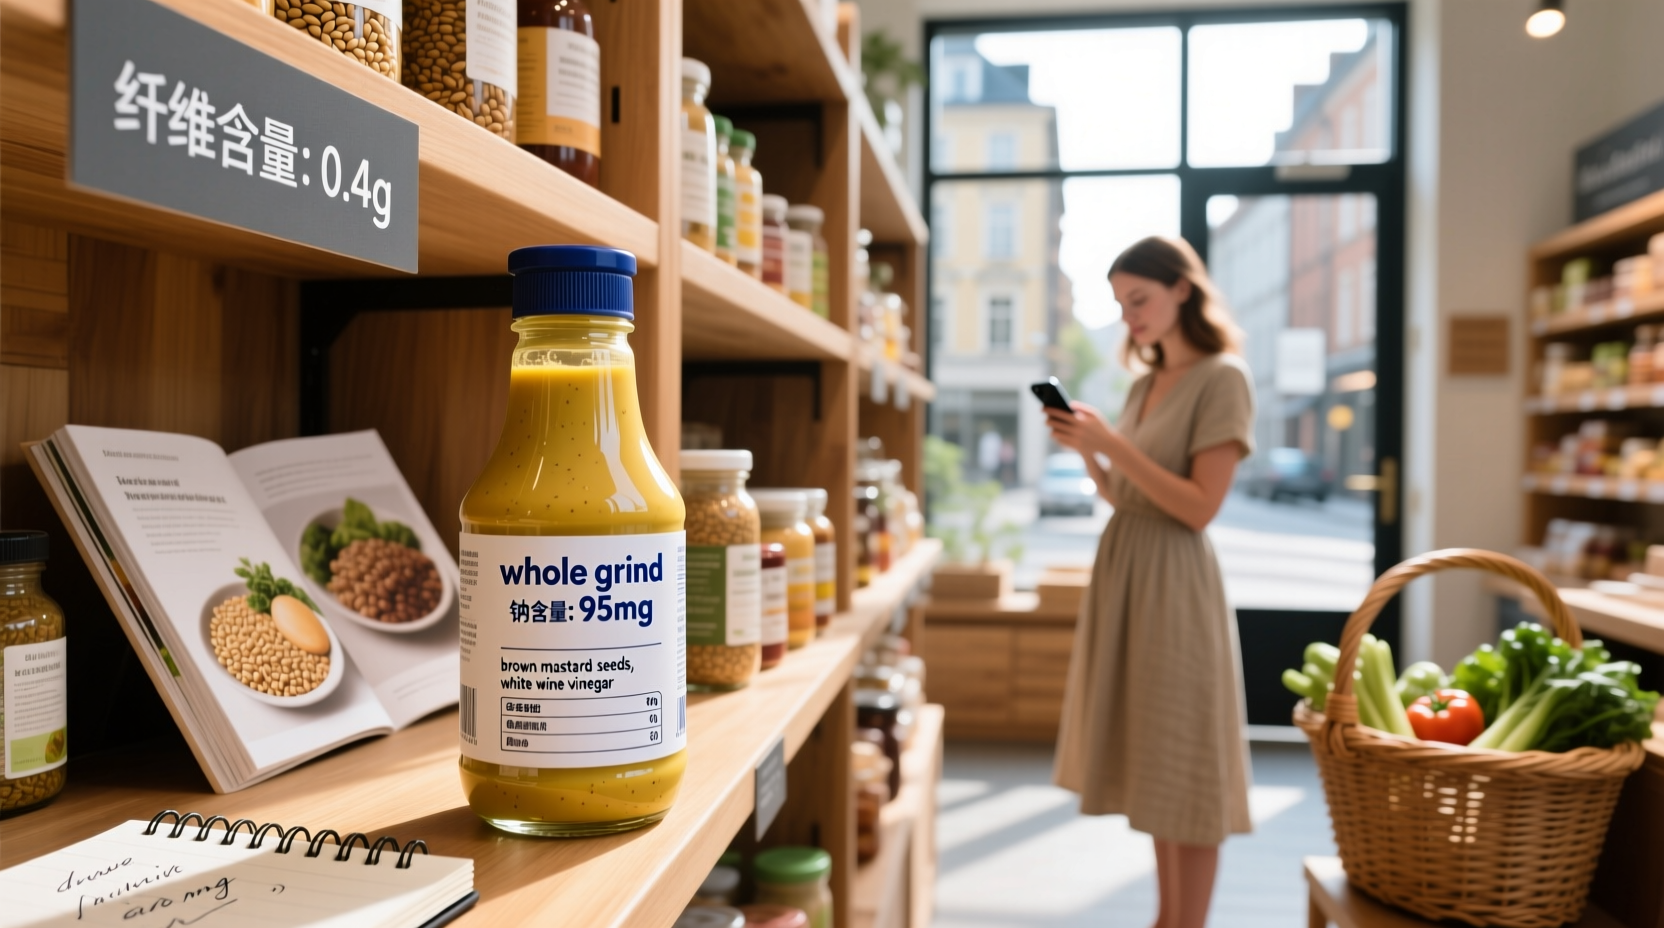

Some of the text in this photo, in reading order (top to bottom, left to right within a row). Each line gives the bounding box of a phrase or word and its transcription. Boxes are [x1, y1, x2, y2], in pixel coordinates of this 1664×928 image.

[113, 60, 392, 230] 纤维含量: 0.4g
[499, 556, 588, 586] whole
[594, 552, 663, 593] grind
[509, 594, 654, 628] 钠含量: 95mg
[500, 656, 538, 673] brown
[596, 655, 635, 674] seeds,
[500, 675, 615, 694] white wine vinegar
